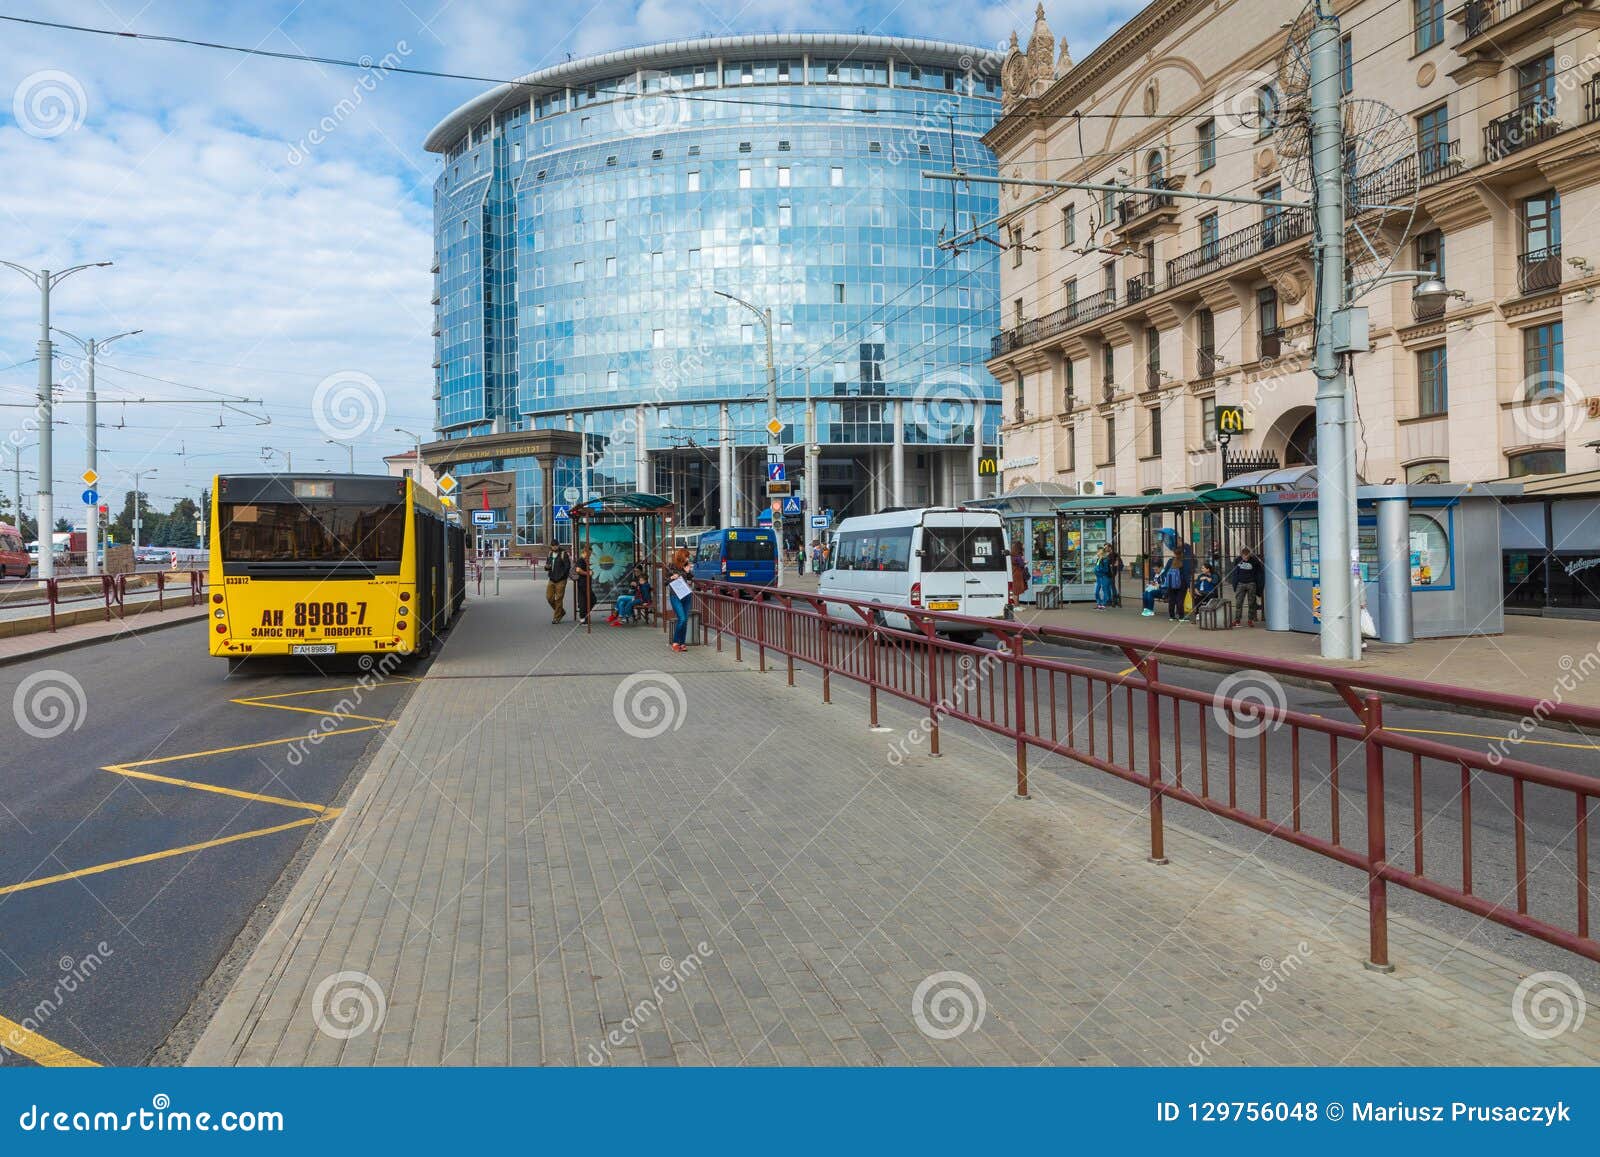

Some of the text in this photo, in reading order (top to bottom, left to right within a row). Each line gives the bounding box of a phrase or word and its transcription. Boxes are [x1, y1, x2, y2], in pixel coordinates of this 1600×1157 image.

[294, 602, 368, 627] 8988-7
[251, 626, 373, 638] ЗАНОС ПРИ ПОВОРОТЕ
